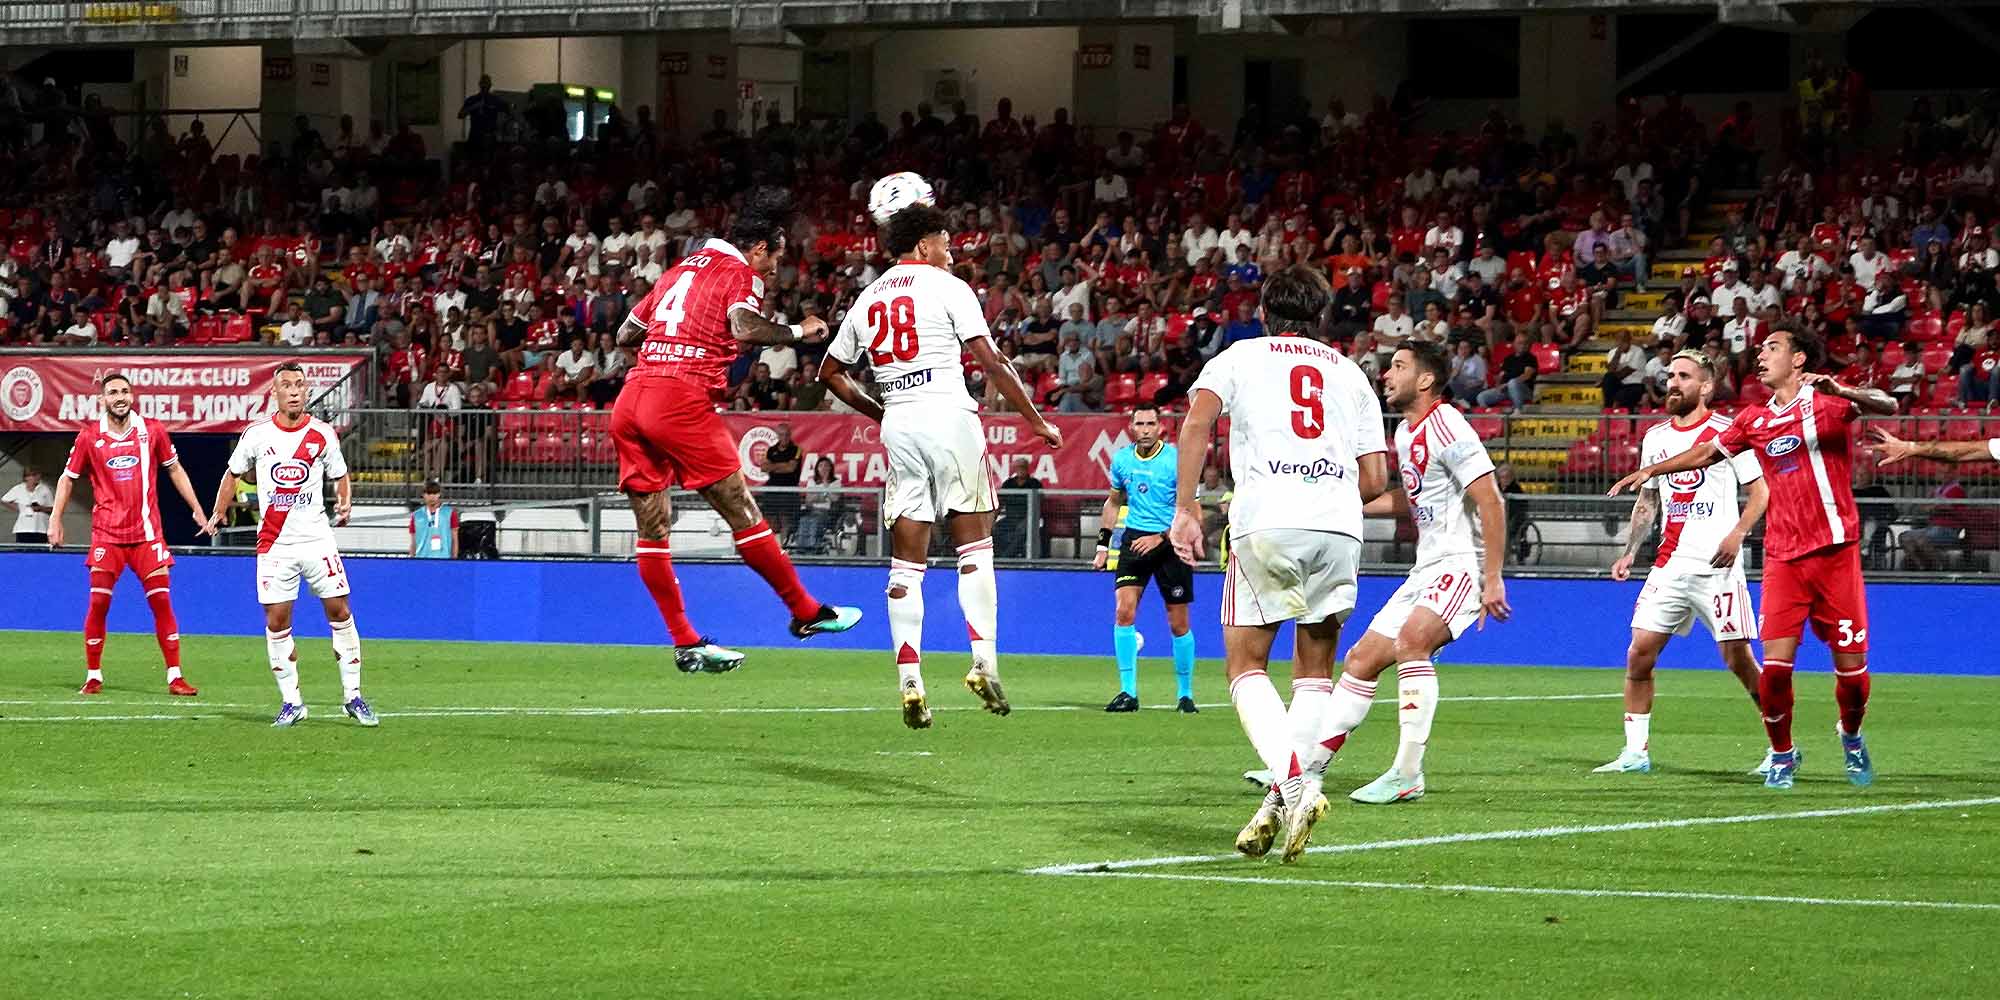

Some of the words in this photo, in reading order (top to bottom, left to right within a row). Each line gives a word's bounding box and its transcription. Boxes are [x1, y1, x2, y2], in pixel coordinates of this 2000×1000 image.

[873, 275, 915, 294] CAPRINI
[655, 270, 696, 337] 4
[868, 295, 920, 367] 28
[647, 341, 707, 359] PULSEE
[1269, 342, 1339, 365] MANCUSO
[119, 368, 192, 386] MONZA
[201, 368, 250, 386] CLUB
[306, 366, 342, 378] AMICI
[138, 394, 187, 421] DEL
[1290, 364, 1324, 439] 9
[851, 425, 876, 444] AC
[277, 468, 302, 479] PATA
[267, 490, 313, 504] Sinergy
[1713, 592, 1733, 618] 37
